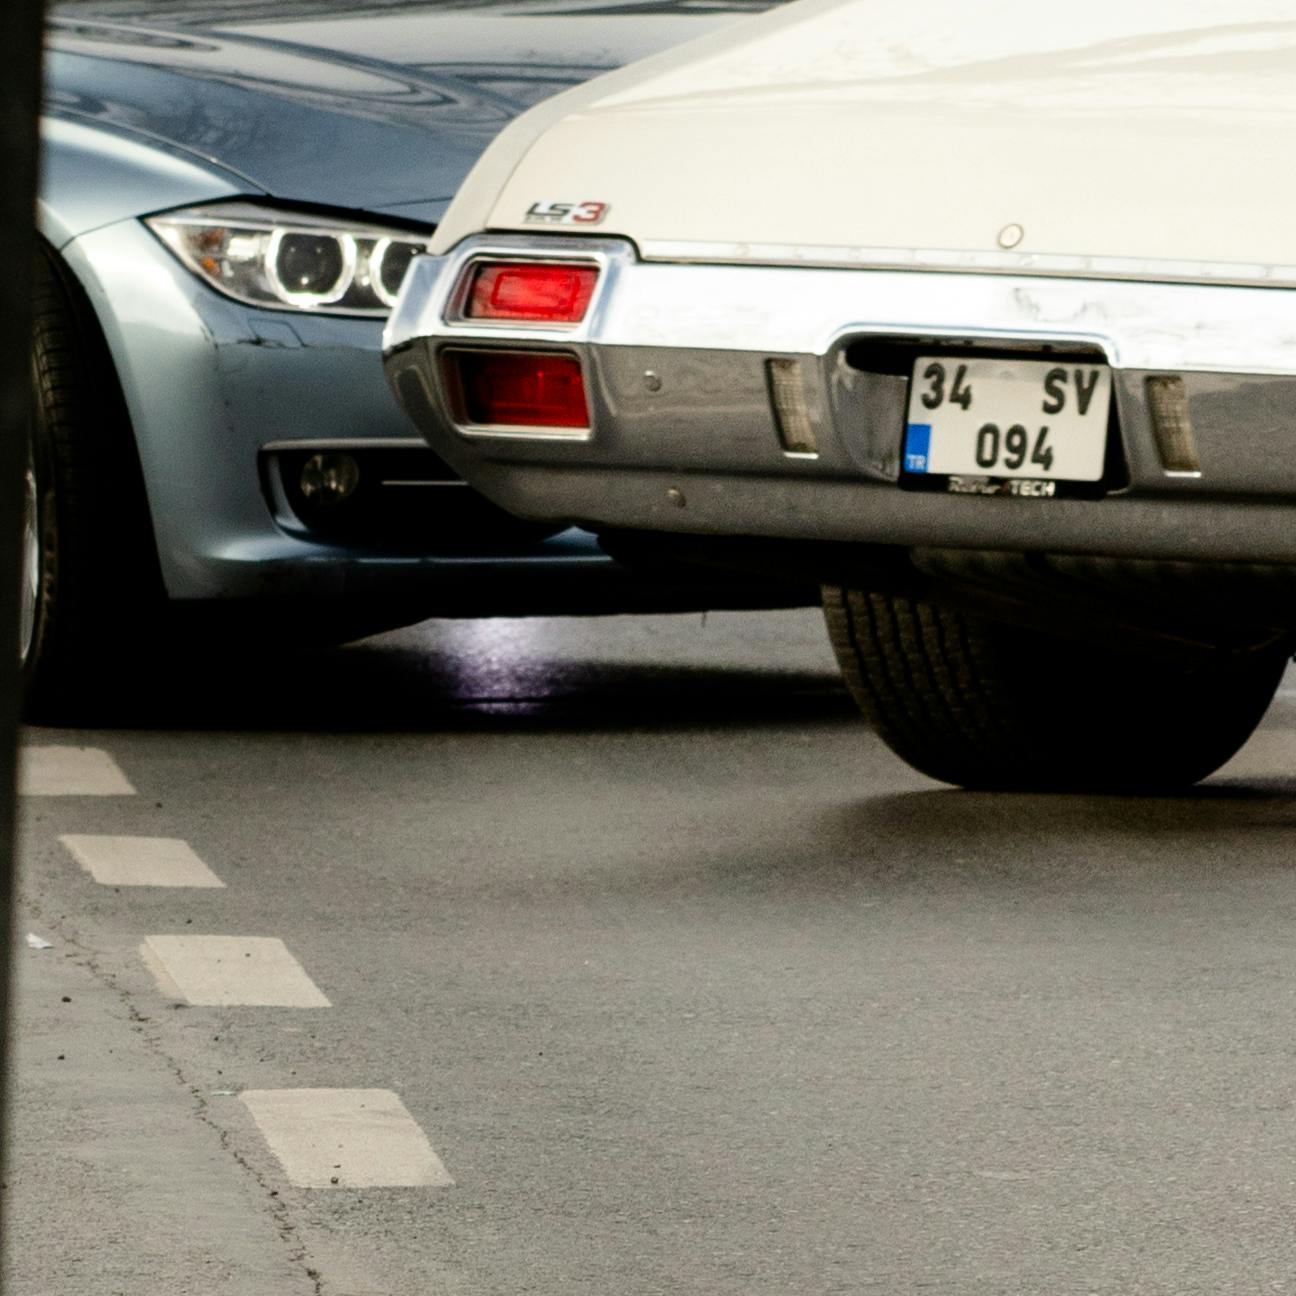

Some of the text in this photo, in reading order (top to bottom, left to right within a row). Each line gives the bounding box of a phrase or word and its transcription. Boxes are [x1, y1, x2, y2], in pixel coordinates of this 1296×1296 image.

[526, 202, 606, 222] LS3
[921, 361, 1100, 416] 34 SV
[906, 454, 926, 469] TR
[975, 422, 1054, 472] 094
